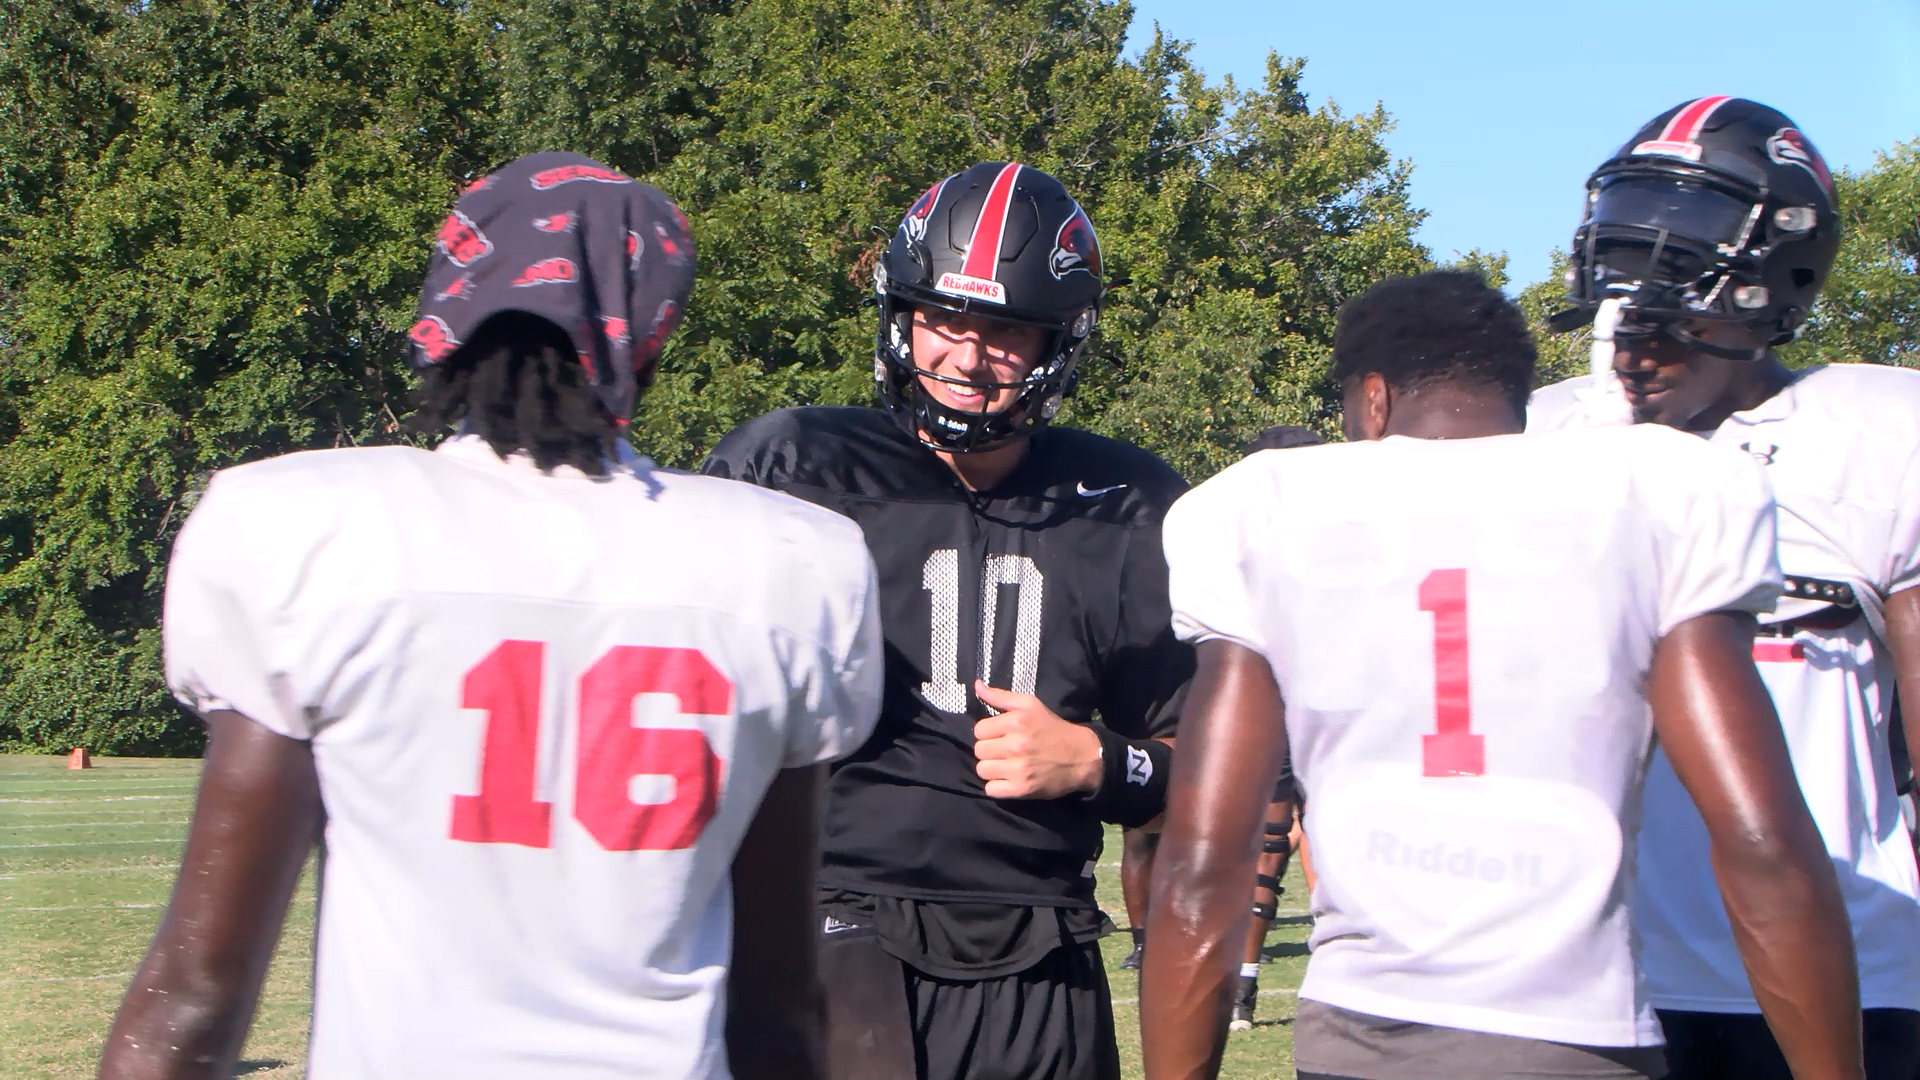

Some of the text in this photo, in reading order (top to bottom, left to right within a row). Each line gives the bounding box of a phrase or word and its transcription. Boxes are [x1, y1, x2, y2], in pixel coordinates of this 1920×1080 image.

[942, 275, 999, 297] REDHAWKS
[938, 415, 968, 431] Rddell
[921, 549, 1043, 716] 10
[1417, 568, 1484, 777] 1
[448, 639, 735, 851] 16
[1366, 829, 1543, 886] Riddell
